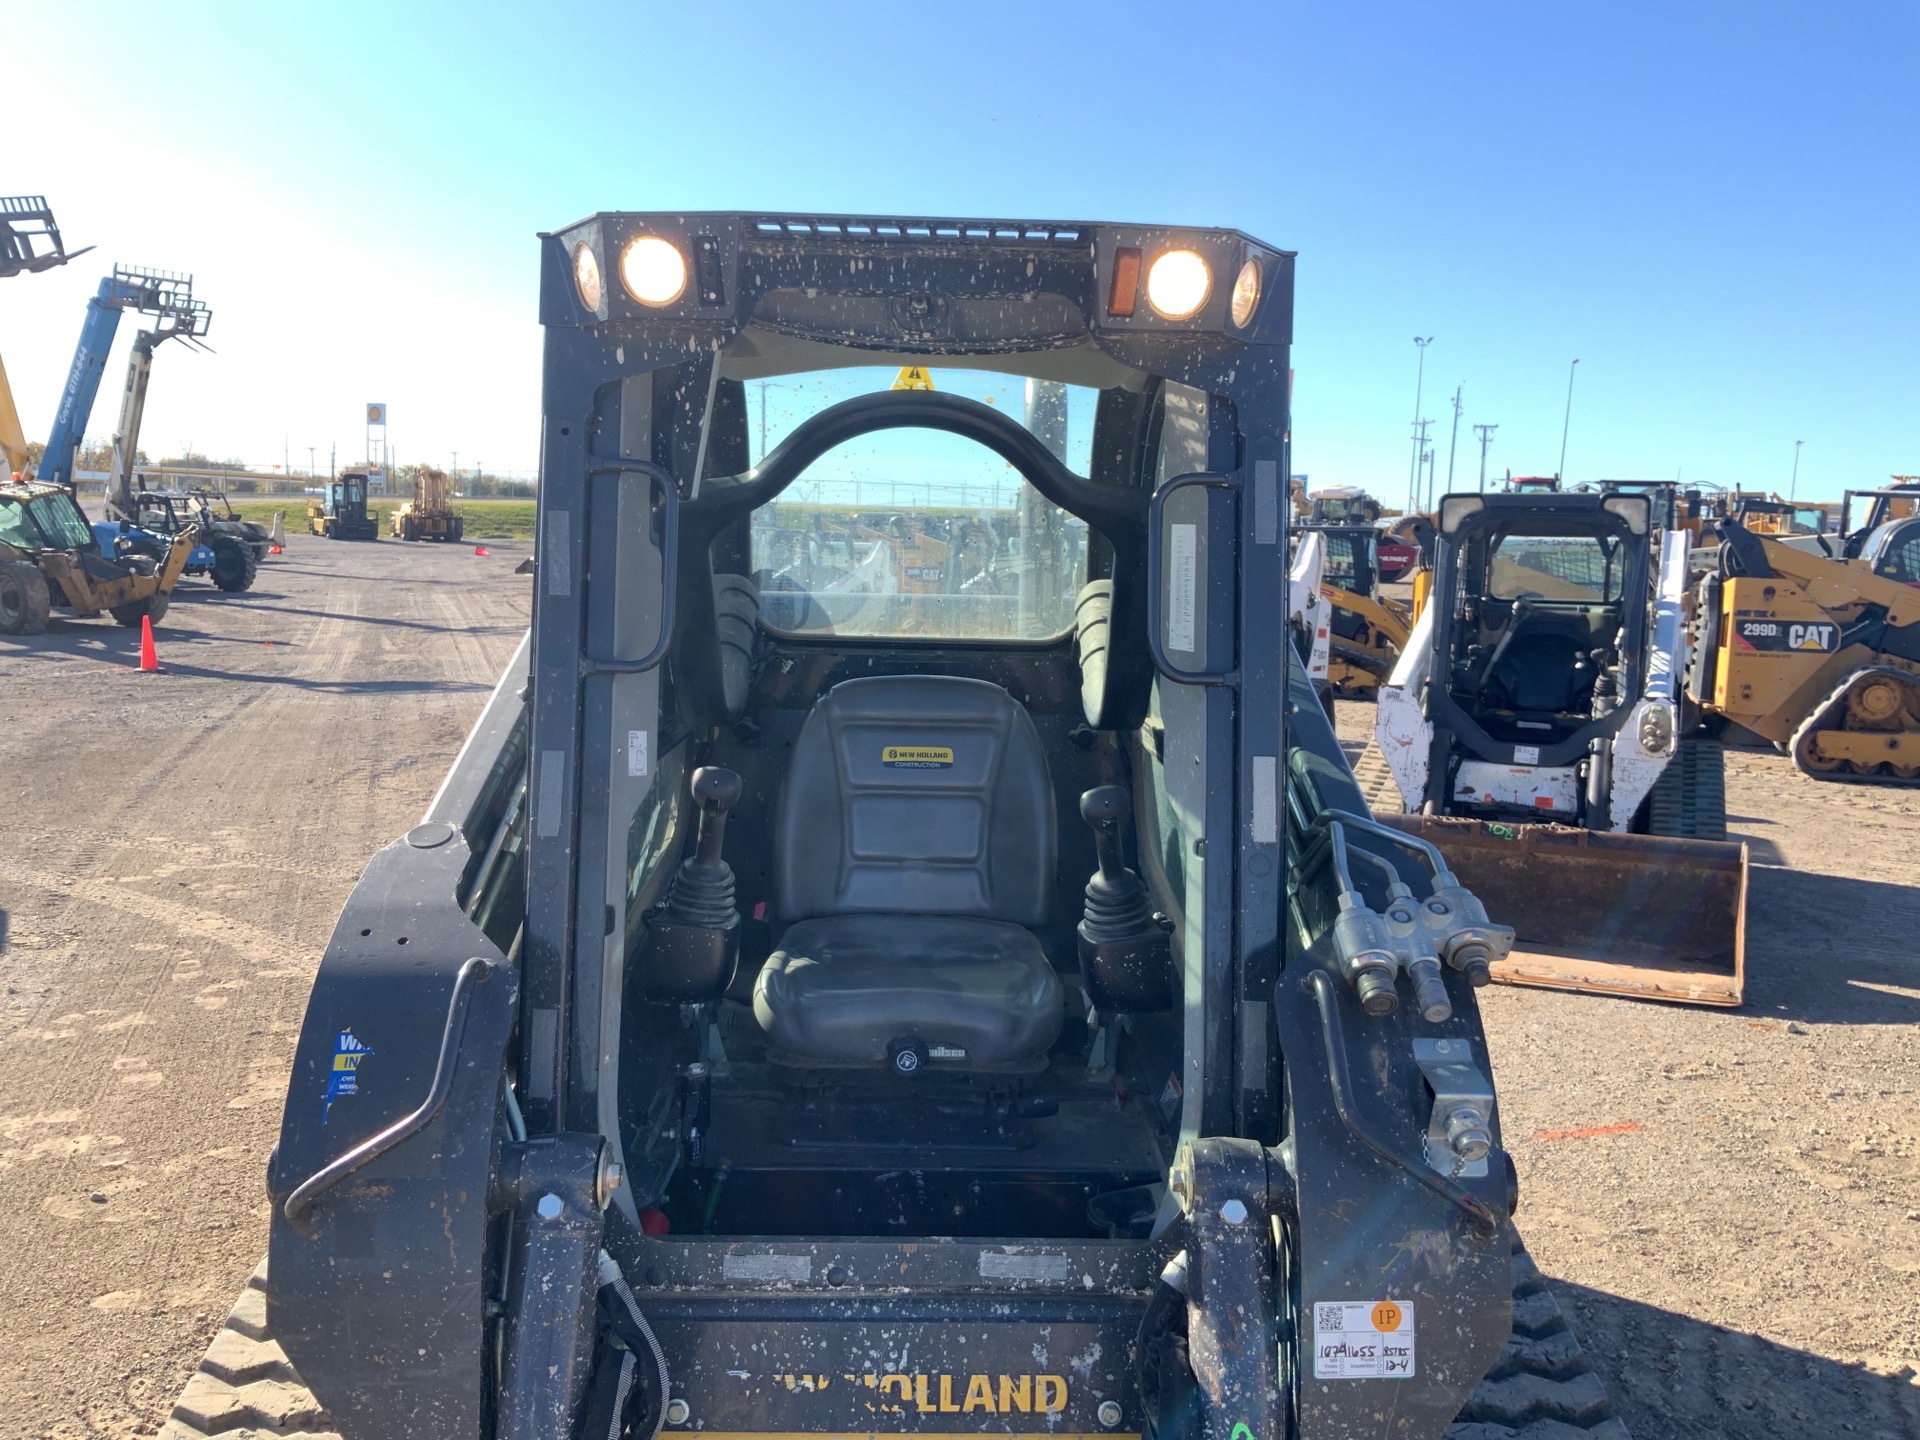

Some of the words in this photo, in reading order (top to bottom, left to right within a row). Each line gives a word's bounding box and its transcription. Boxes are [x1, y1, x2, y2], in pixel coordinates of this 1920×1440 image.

[69, 345, 88, 394] GTH-844
[1789, 624, 1834, 650] CAT
[928, 1046, 966, 1057] milsco
[1378, 1309, 1396, 1325] IP
[1385, 1359, 1409, 1373] 12-4
